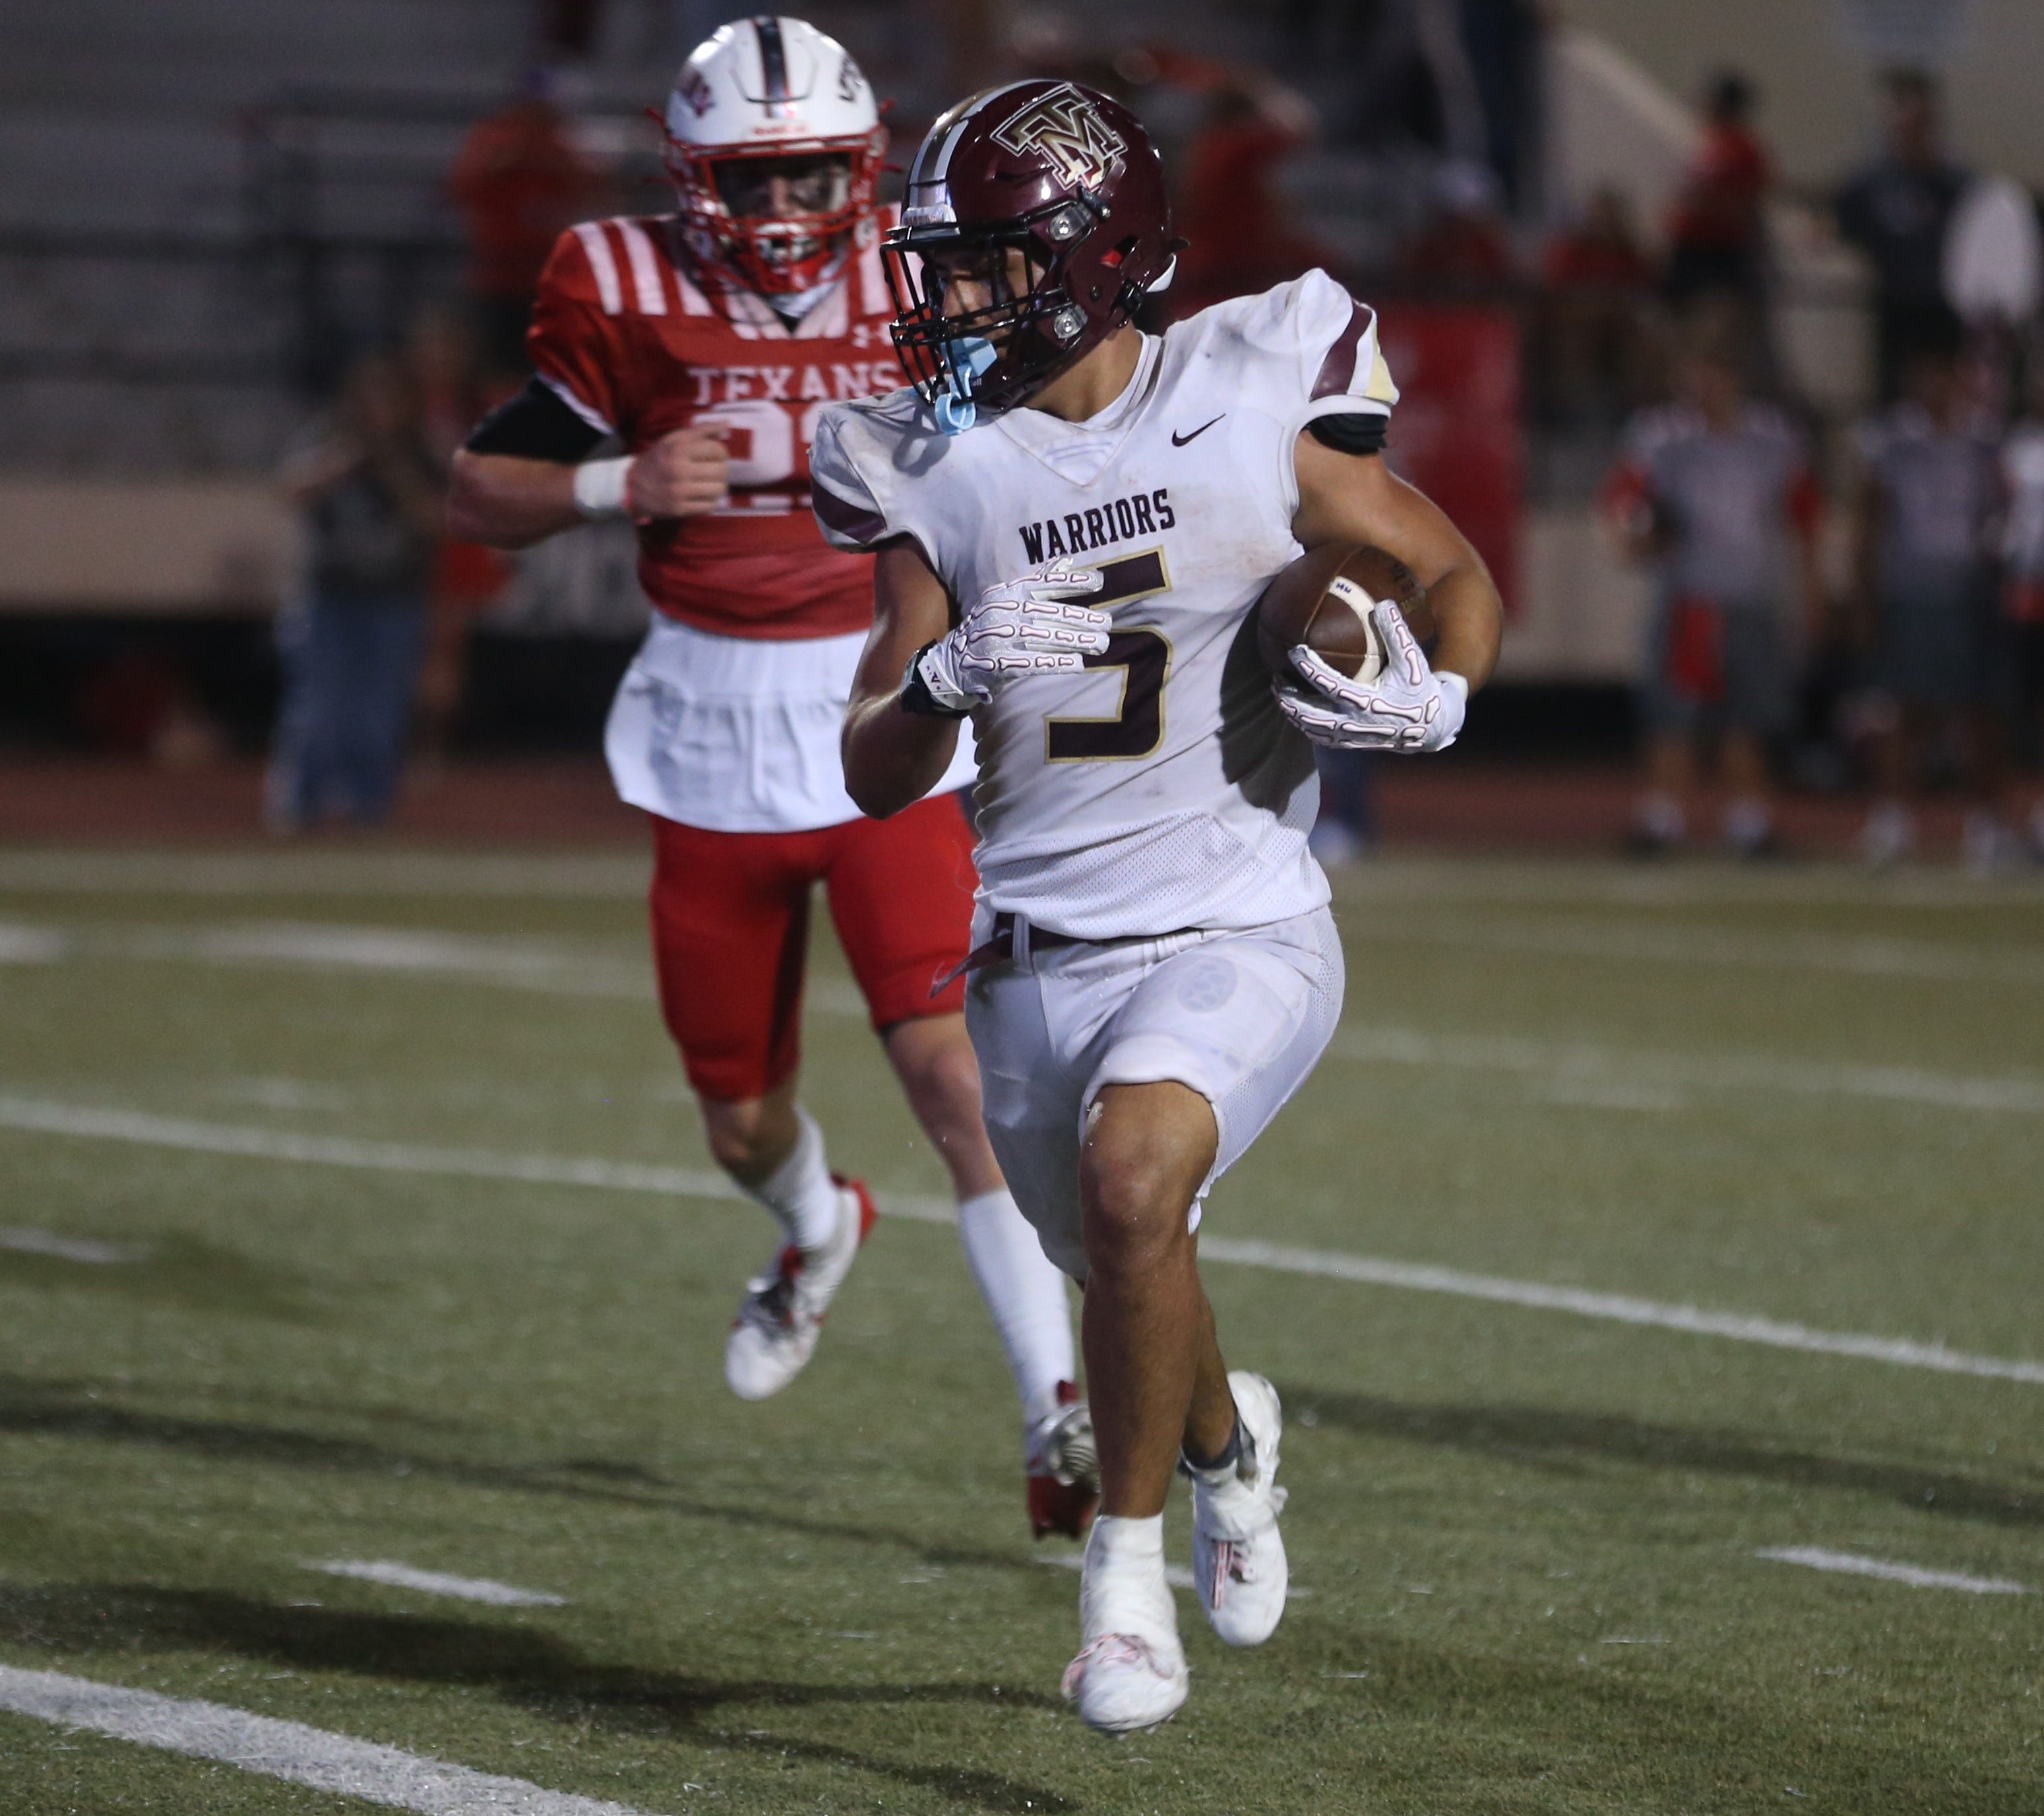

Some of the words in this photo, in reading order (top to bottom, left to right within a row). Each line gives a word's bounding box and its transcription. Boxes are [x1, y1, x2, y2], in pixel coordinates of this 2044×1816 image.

[989, 82, 1129, 193] TM
[687, 361, 901, 406] TEXANS
[1019, 488, 1175, 565] WARRIORS
[1042, 544, 1173, 765] 5
